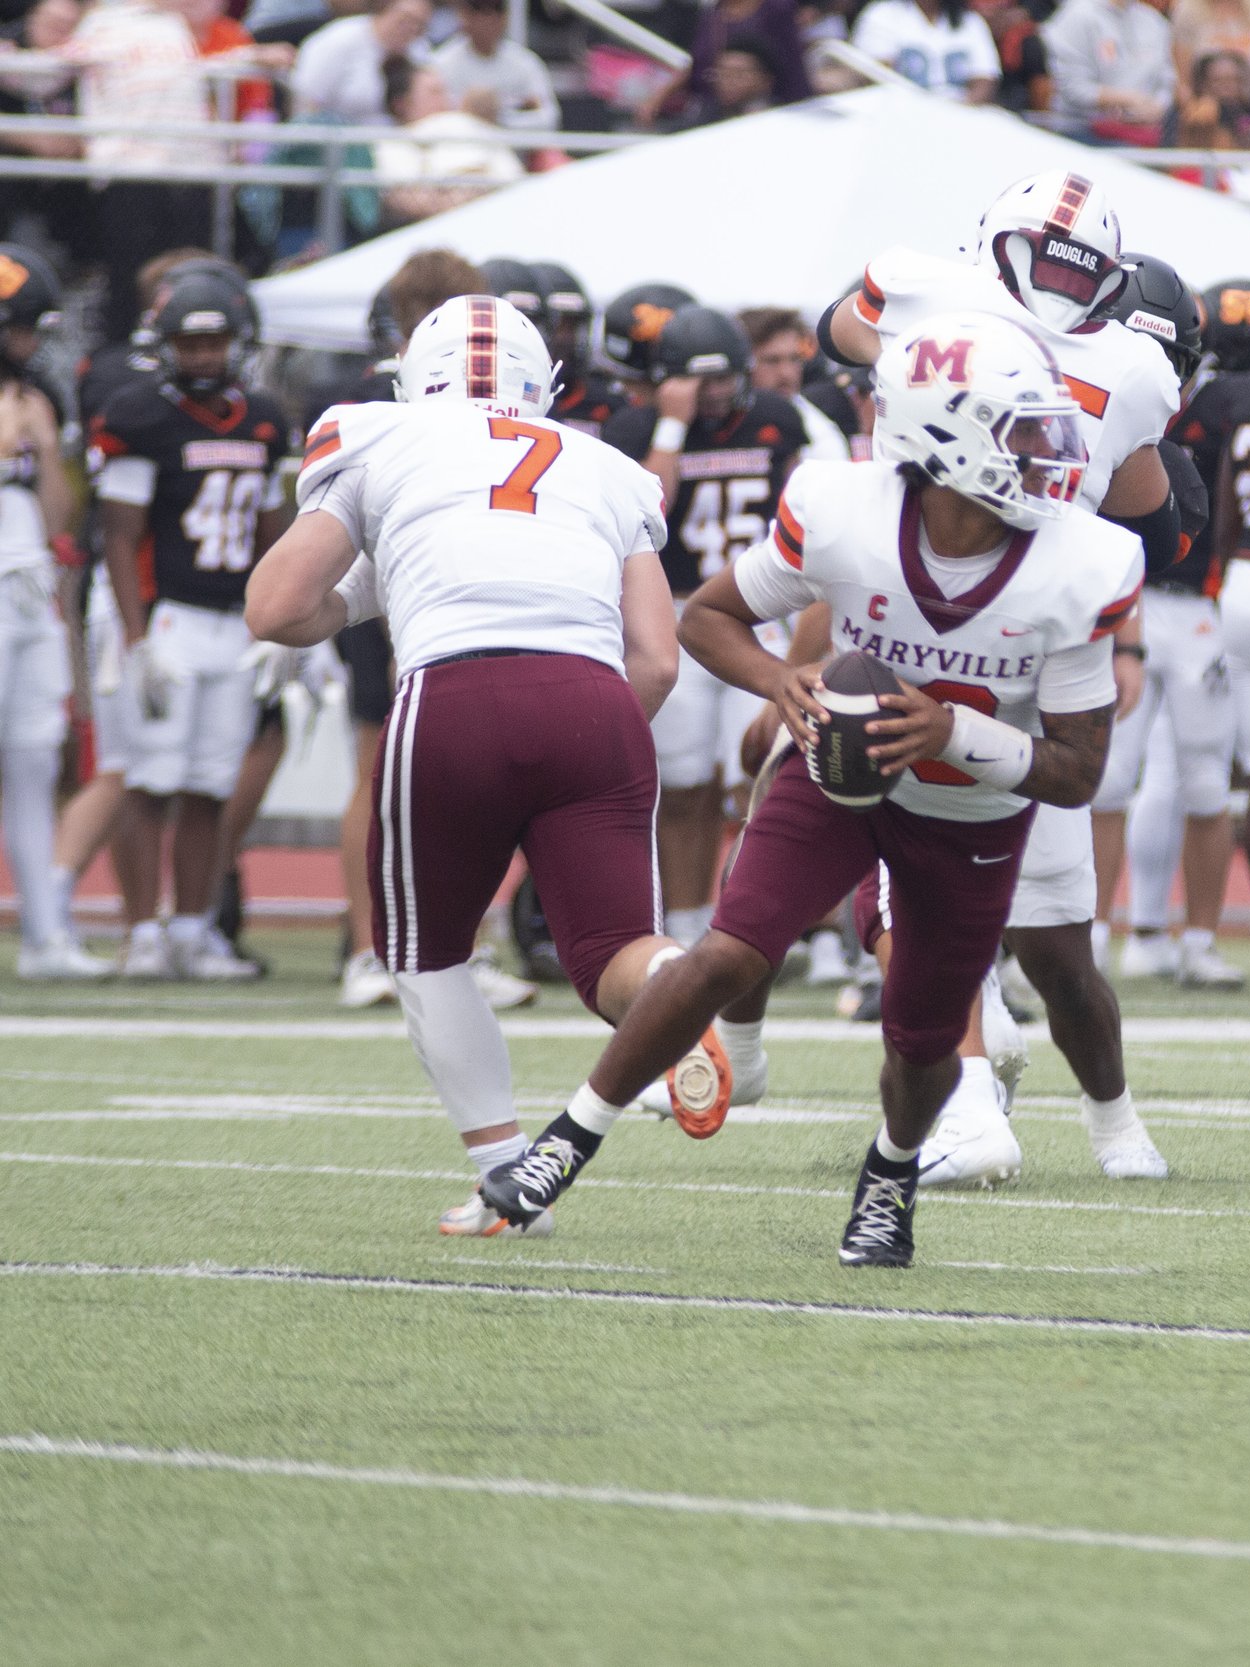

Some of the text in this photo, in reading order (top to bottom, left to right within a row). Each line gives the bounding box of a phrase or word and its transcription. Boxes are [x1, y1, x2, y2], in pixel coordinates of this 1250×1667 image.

[1134, 315, 1174, 337] Riddell
[906, 339, 974, 388] M
[487, 417, 563, 515] 7
[182, 471, 262, 571] 40
[680, 478, 770, 578] 45
[868, 595, 888, 621] C
[842, 616, 1034, 679] MARYVILLE
[826, 731, 844, 784] Wilson
